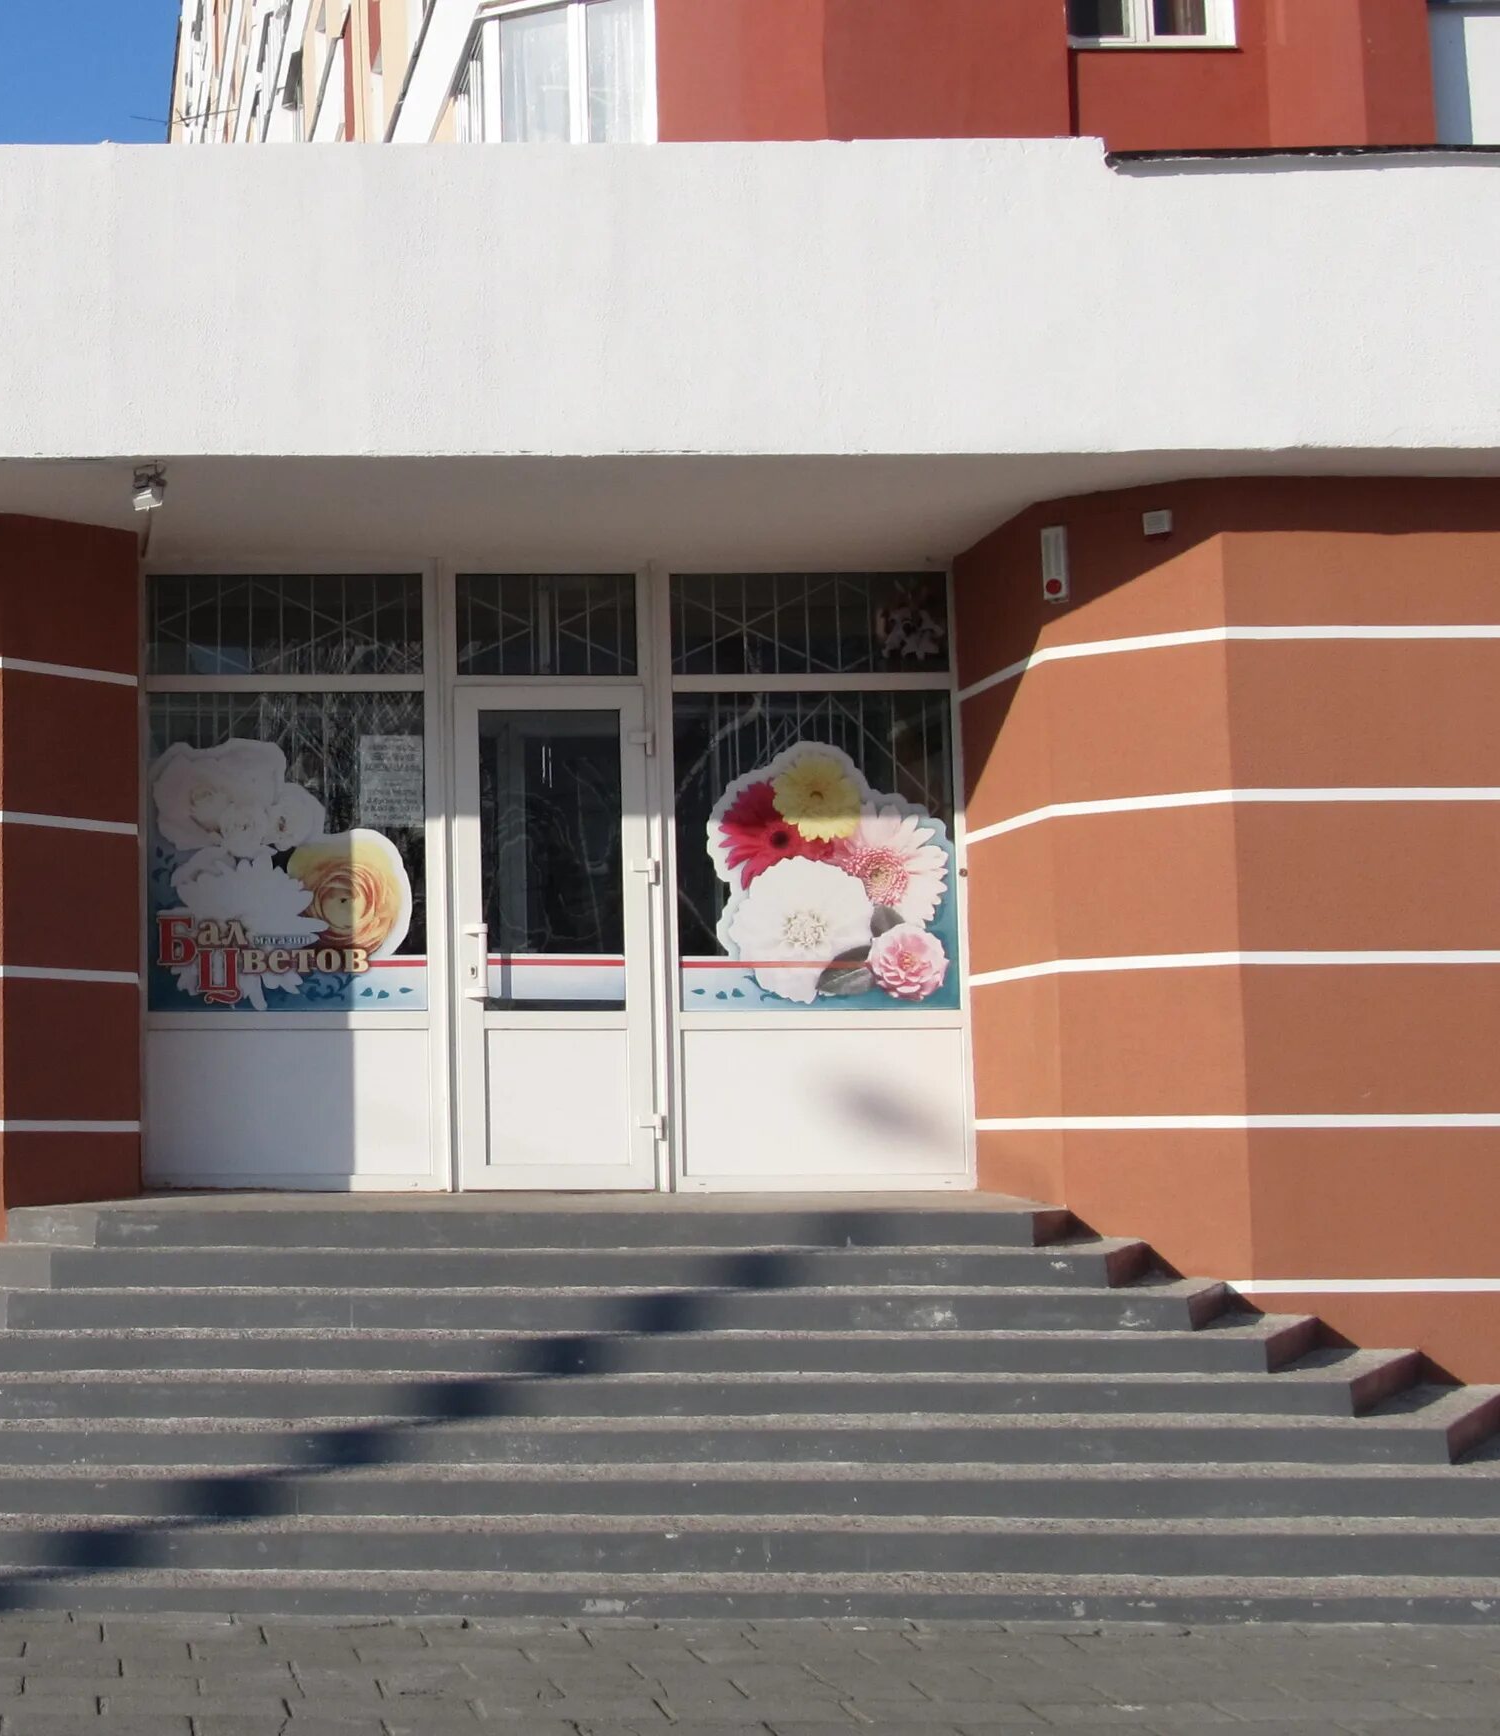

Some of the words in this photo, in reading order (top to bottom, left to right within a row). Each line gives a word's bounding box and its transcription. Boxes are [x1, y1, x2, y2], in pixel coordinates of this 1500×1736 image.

[156, 915, 249, 967] Бал
[252, 935, 311, 946] магазин
[197, 947, 370, 1004] Цветов
